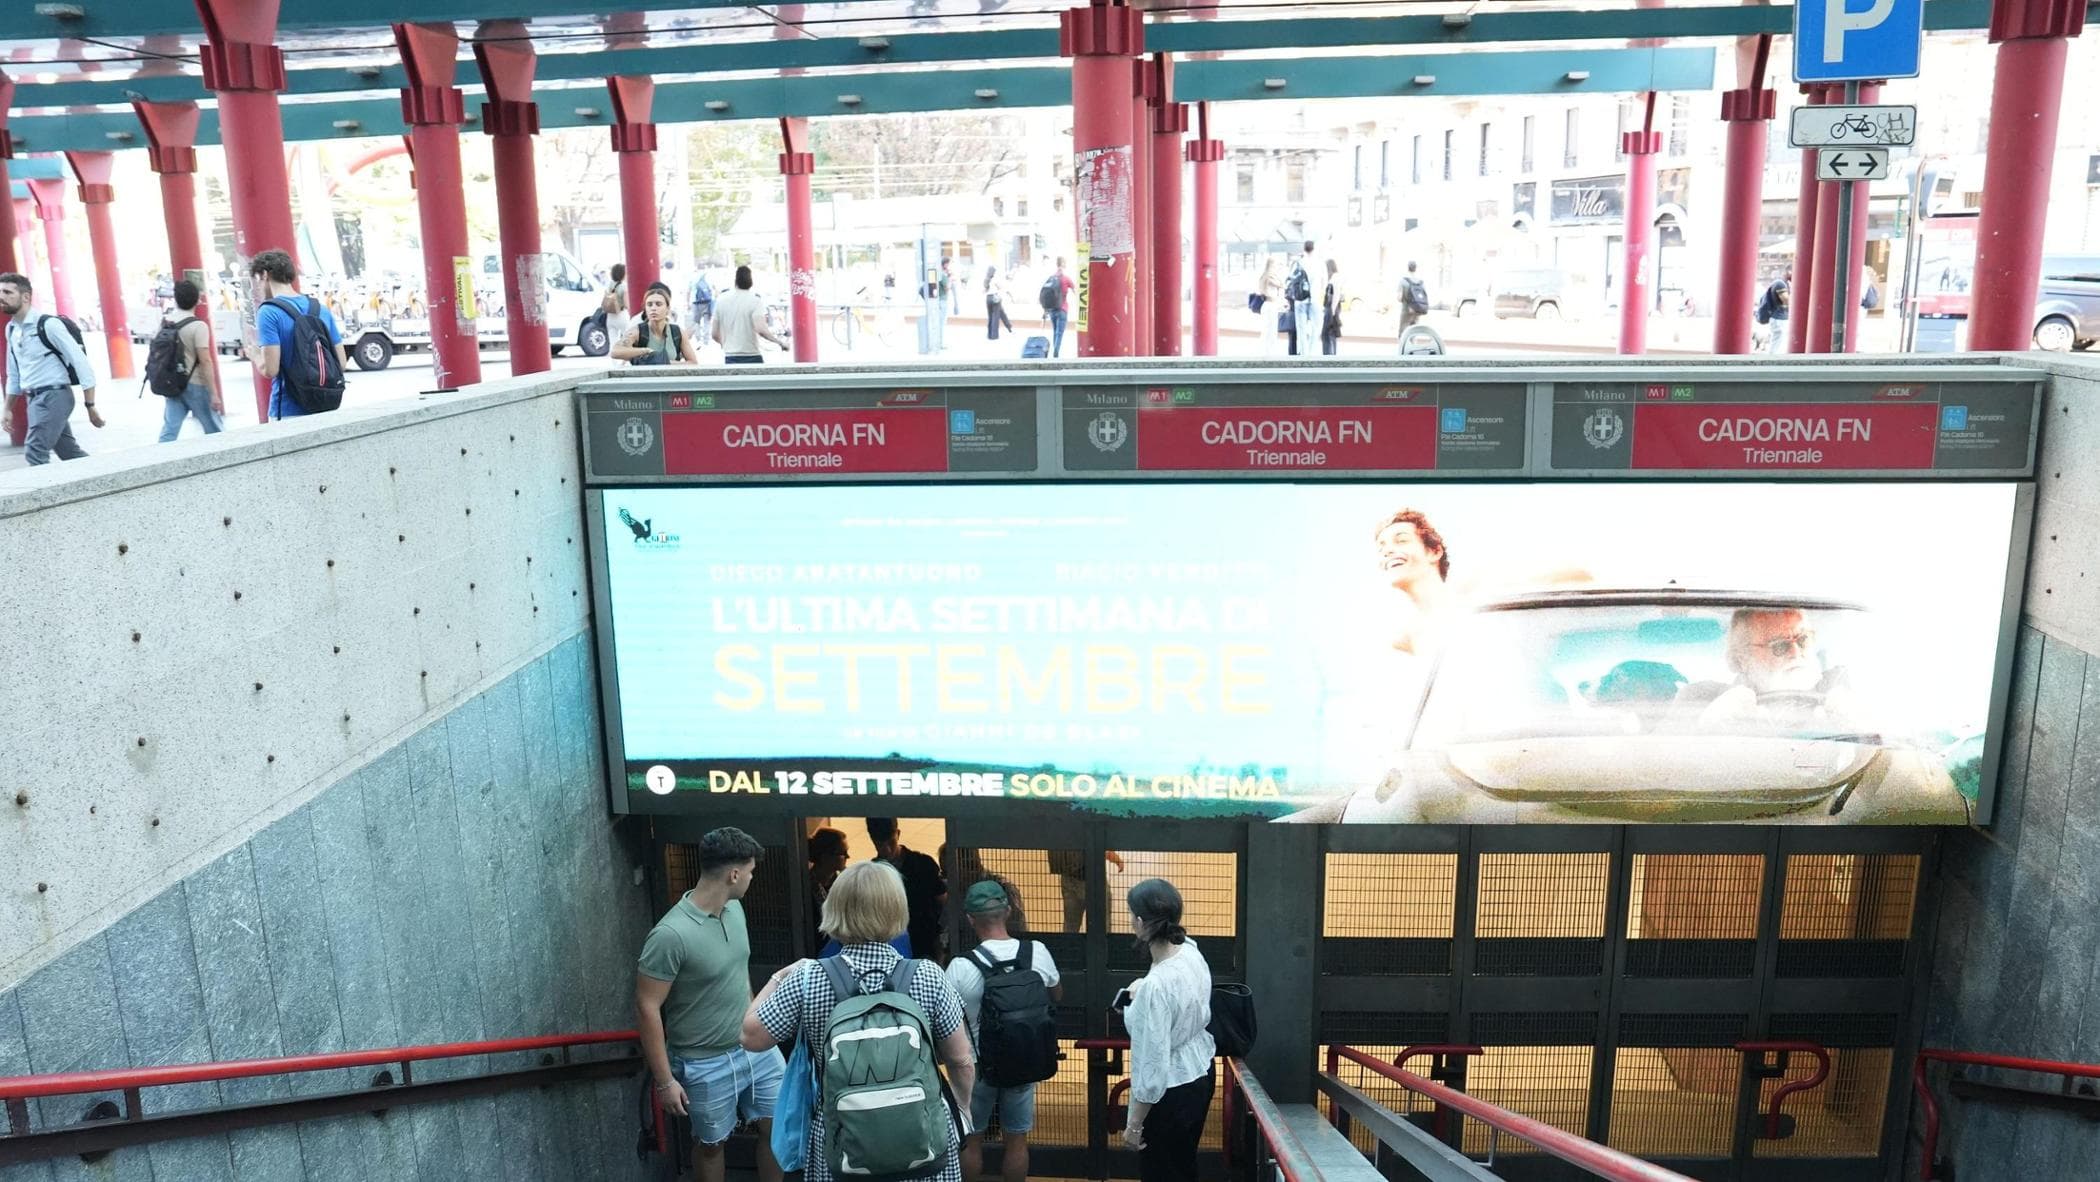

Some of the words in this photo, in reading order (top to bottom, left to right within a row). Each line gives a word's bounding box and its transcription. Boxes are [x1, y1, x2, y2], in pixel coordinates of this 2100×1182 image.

[1823, 0, 1894, 63] P
[895, 393, 917, 401] ATM
[1087, 394, 1127, 404] Milano
[1150, 391, 1166, 400] M1
[1175, 391, 1193, 400] M2
[1385, 391, 1408, 399] ATM
[1584, 390, 1625, 400] Milano
[1648, 388, 1665, 397] M1
[1674, 388, 1691, 397] M2
[1887, 388, 1910, 396] ATM
[614, 400, 653, 410] Milano
[672, 397, 688, 406] M1
[696, 396, 713, 405] M2
[723, 423, 847, 447] CADORNA
[853, 423, 885, 446] FN
[1202, 420, 1332, 444] CADORNA
[1338, 420, 1372, 443] FN
[1699, 418, 1830, 442] CADORNA
[1836, 418, 1872, 441] FN
[767, 452, 843, 468] Triennale
[1247, 450, 1326, 465] Triennale
[1743, 448, 1823, 463] Triennale
[711, 595, 924, 633] L'ULTIMA
[931, 594, 1213, 633] SETTIMANA
[711, 641, 1273, 717] SETTEMBRE
[708, 770, 770, 794] DAL
[774, 771, 808, 794] 12
[812, 772, 1004, 797] SETTEMBRE
[1010, 773, 1097, 798] SOLO
[1102, 774, 1145, 798] AL
[1150, 774, 1281, 798] CINEMA
